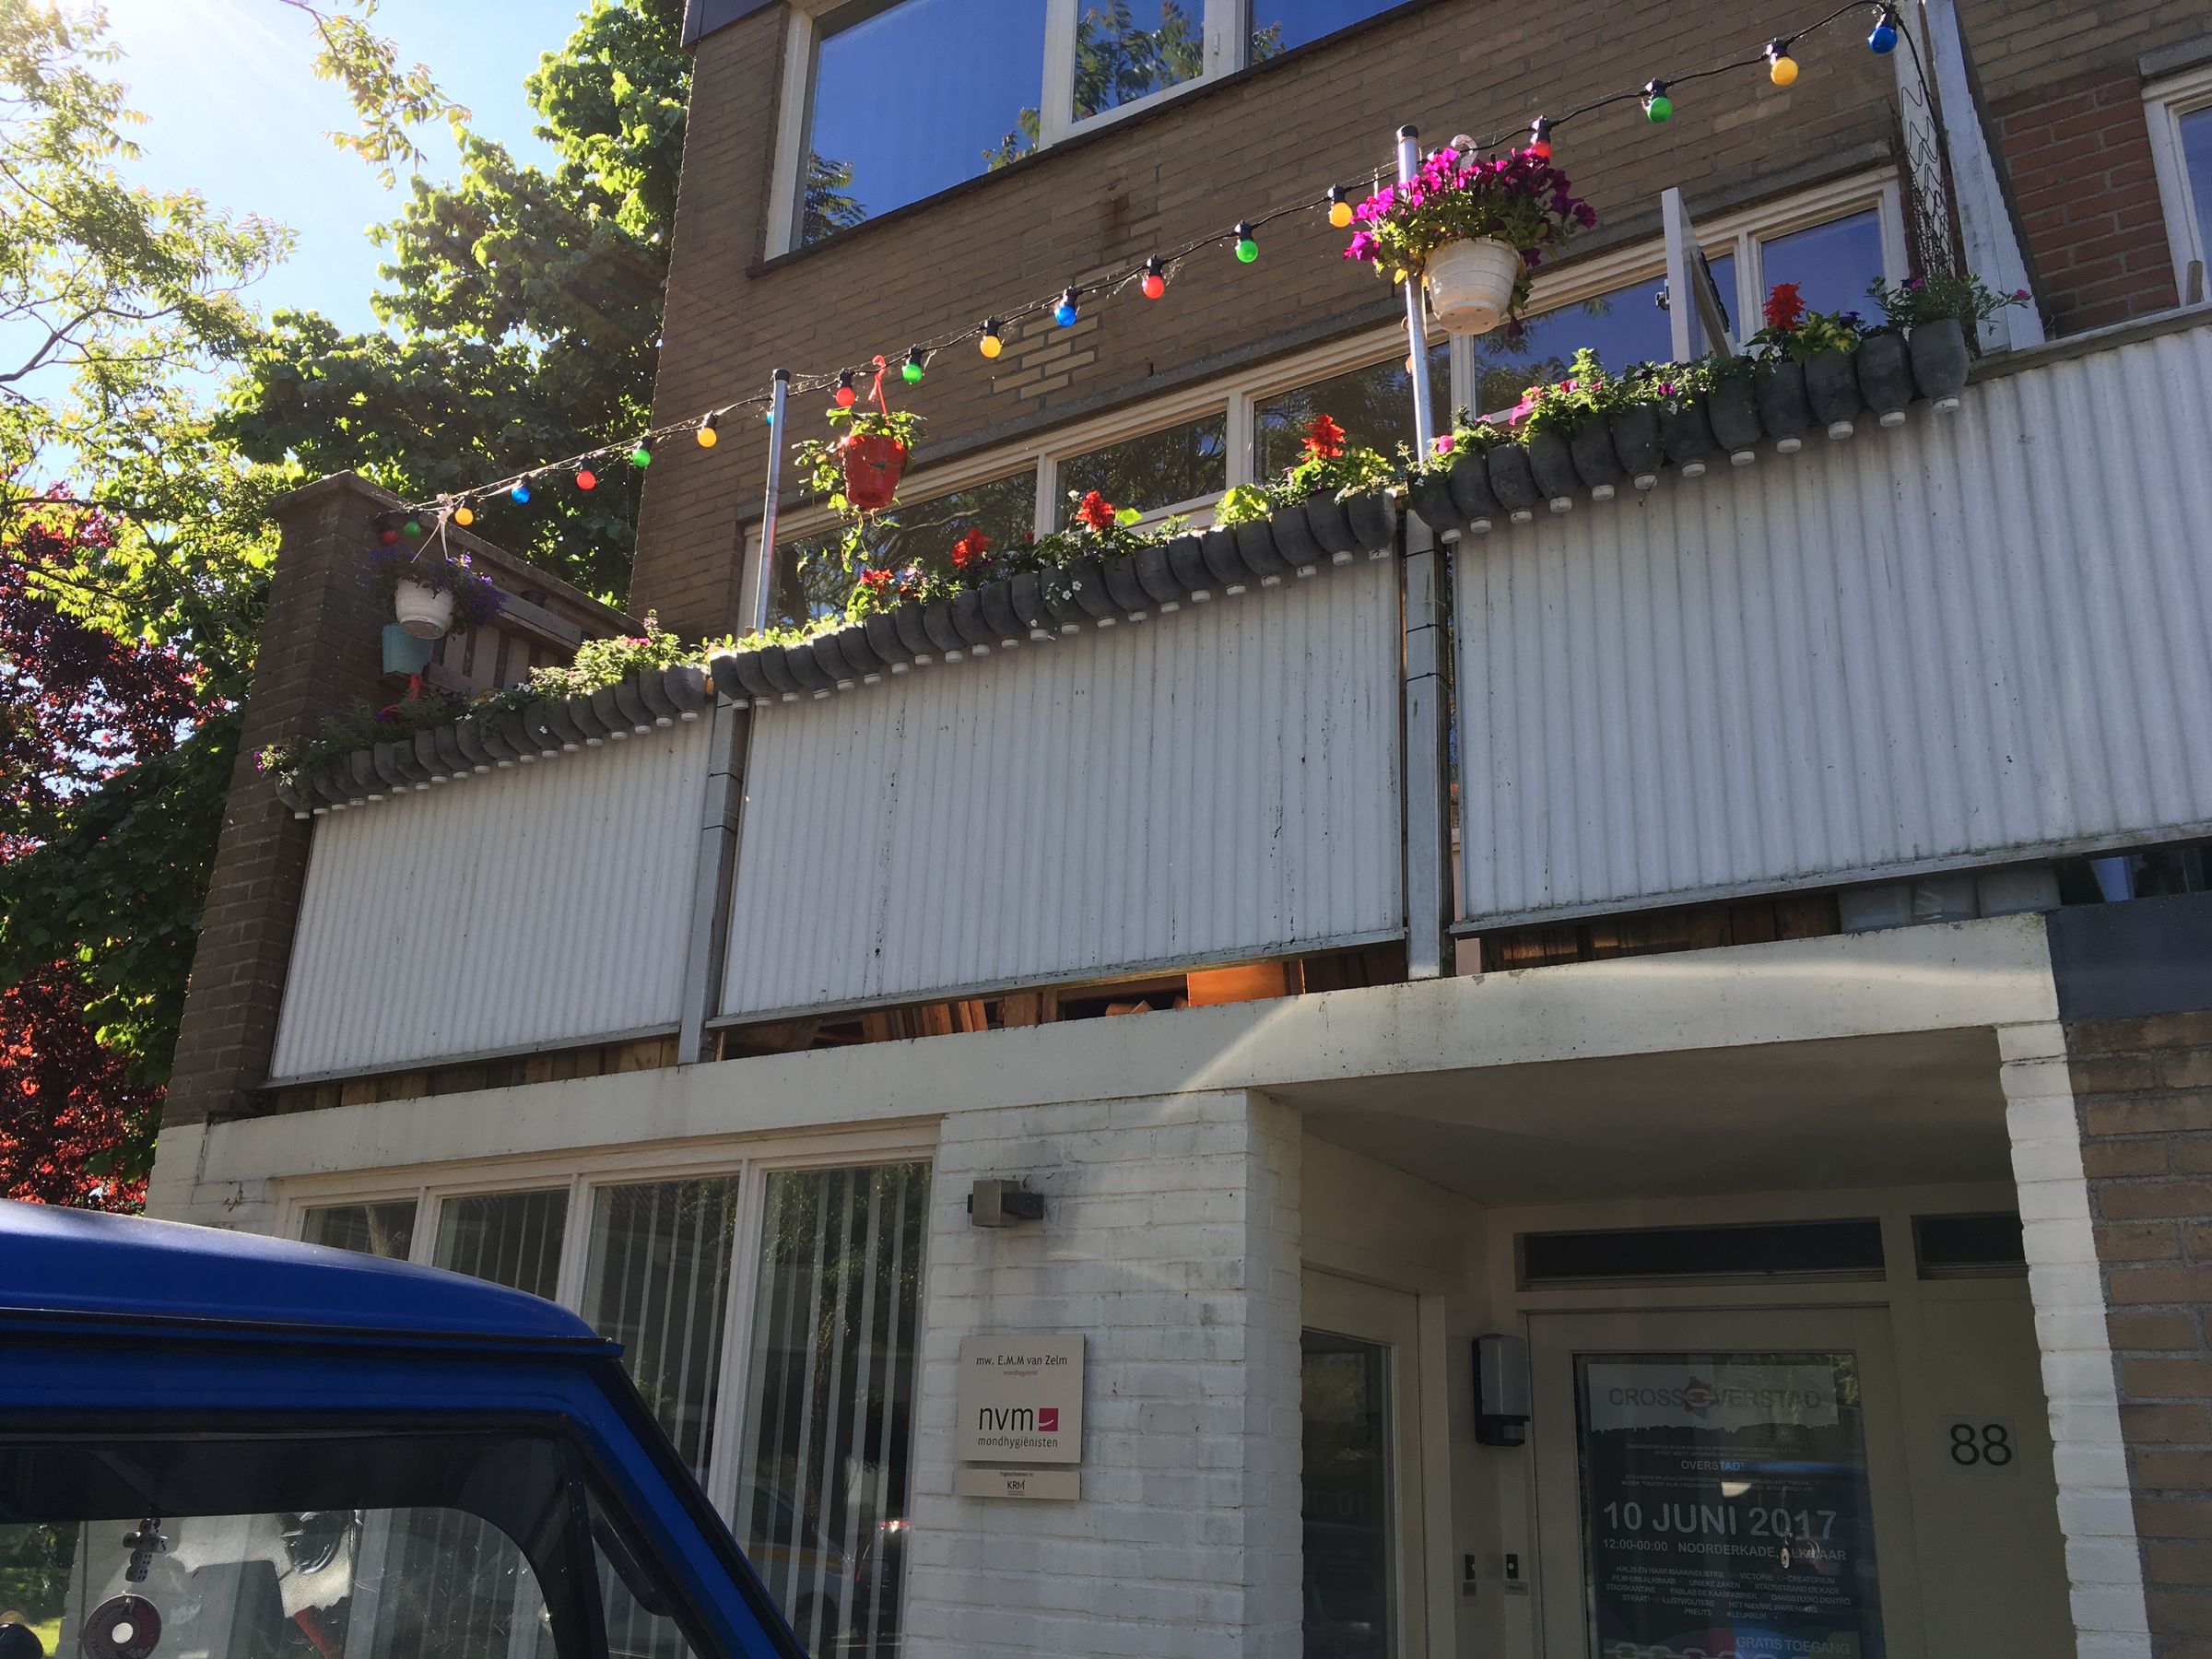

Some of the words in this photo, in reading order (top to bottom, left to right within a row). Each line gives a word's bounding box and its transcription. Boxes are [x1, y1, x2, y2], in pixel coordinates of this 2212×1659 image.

[977, 1357, 994, 1366] mw.
[1027, 1357, 1042, 1366] van
[1045, 1355, 1067, 1366] Zelm
[979, 1407, 1033, 1430] nvm
[977, 1436, 1058, 1449] mondhygiënisten
[1950, 1424, 2012, 1465] 88
[1604, 1501, 1642, 1530] 10
[1653, 1502, 1736, 1535] JUNI
[1749, 1508, 1837, 1540] 2017
[1604, 1538, 1668, 1551] 12:00-00:00
[1735, 1636, 1783, 1650] GRATIS
[1783, 1639, 1851, 1655] TOEGANG
